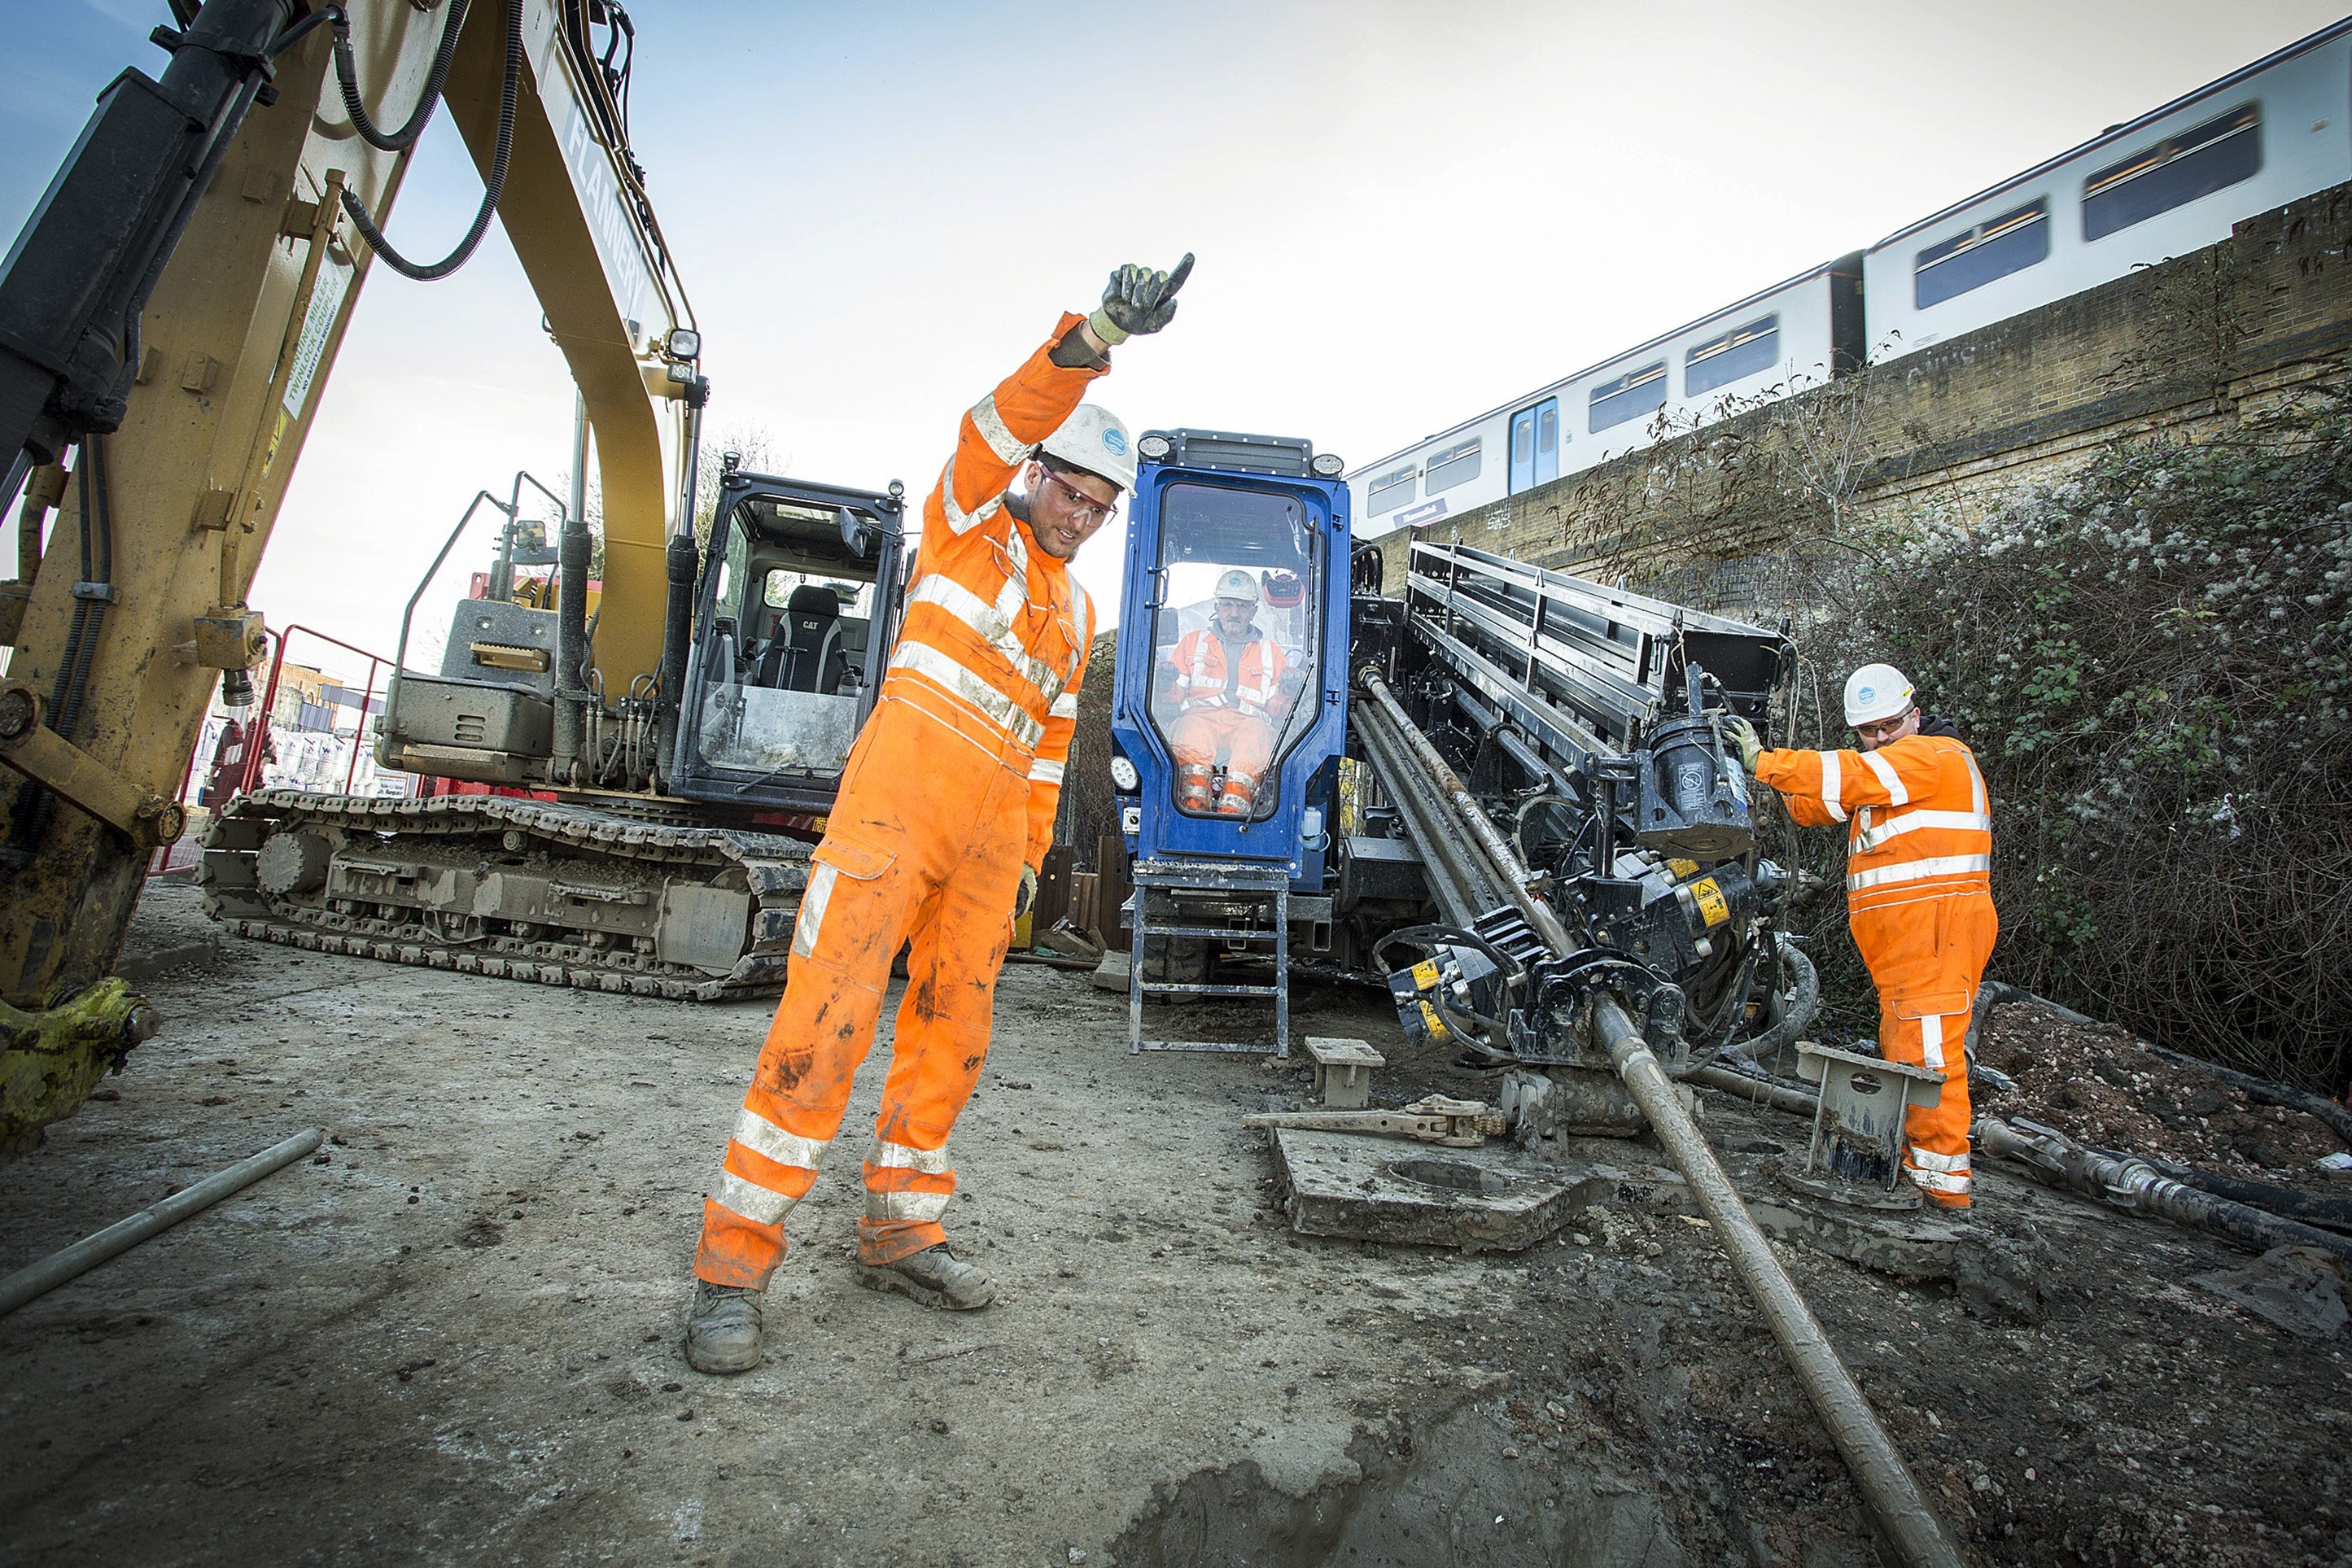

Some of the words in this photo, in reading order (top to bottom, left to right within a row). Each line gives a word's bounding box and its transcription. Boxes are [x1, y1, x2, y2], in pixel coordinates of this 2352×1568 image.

[569, 104, 645, 311] FLANNERY
[289, 338, 317, 400] TWINLOCK
[316, 277, 339, 334] COUPLER
[309, 279, 330, 324] MILLER
[302, 380, 309, 391] NO
[307, 351, 319, 379] SAFETY
[322, 304, 337, 338] REQUIRED
[802, 621, 819, 630] CAT
